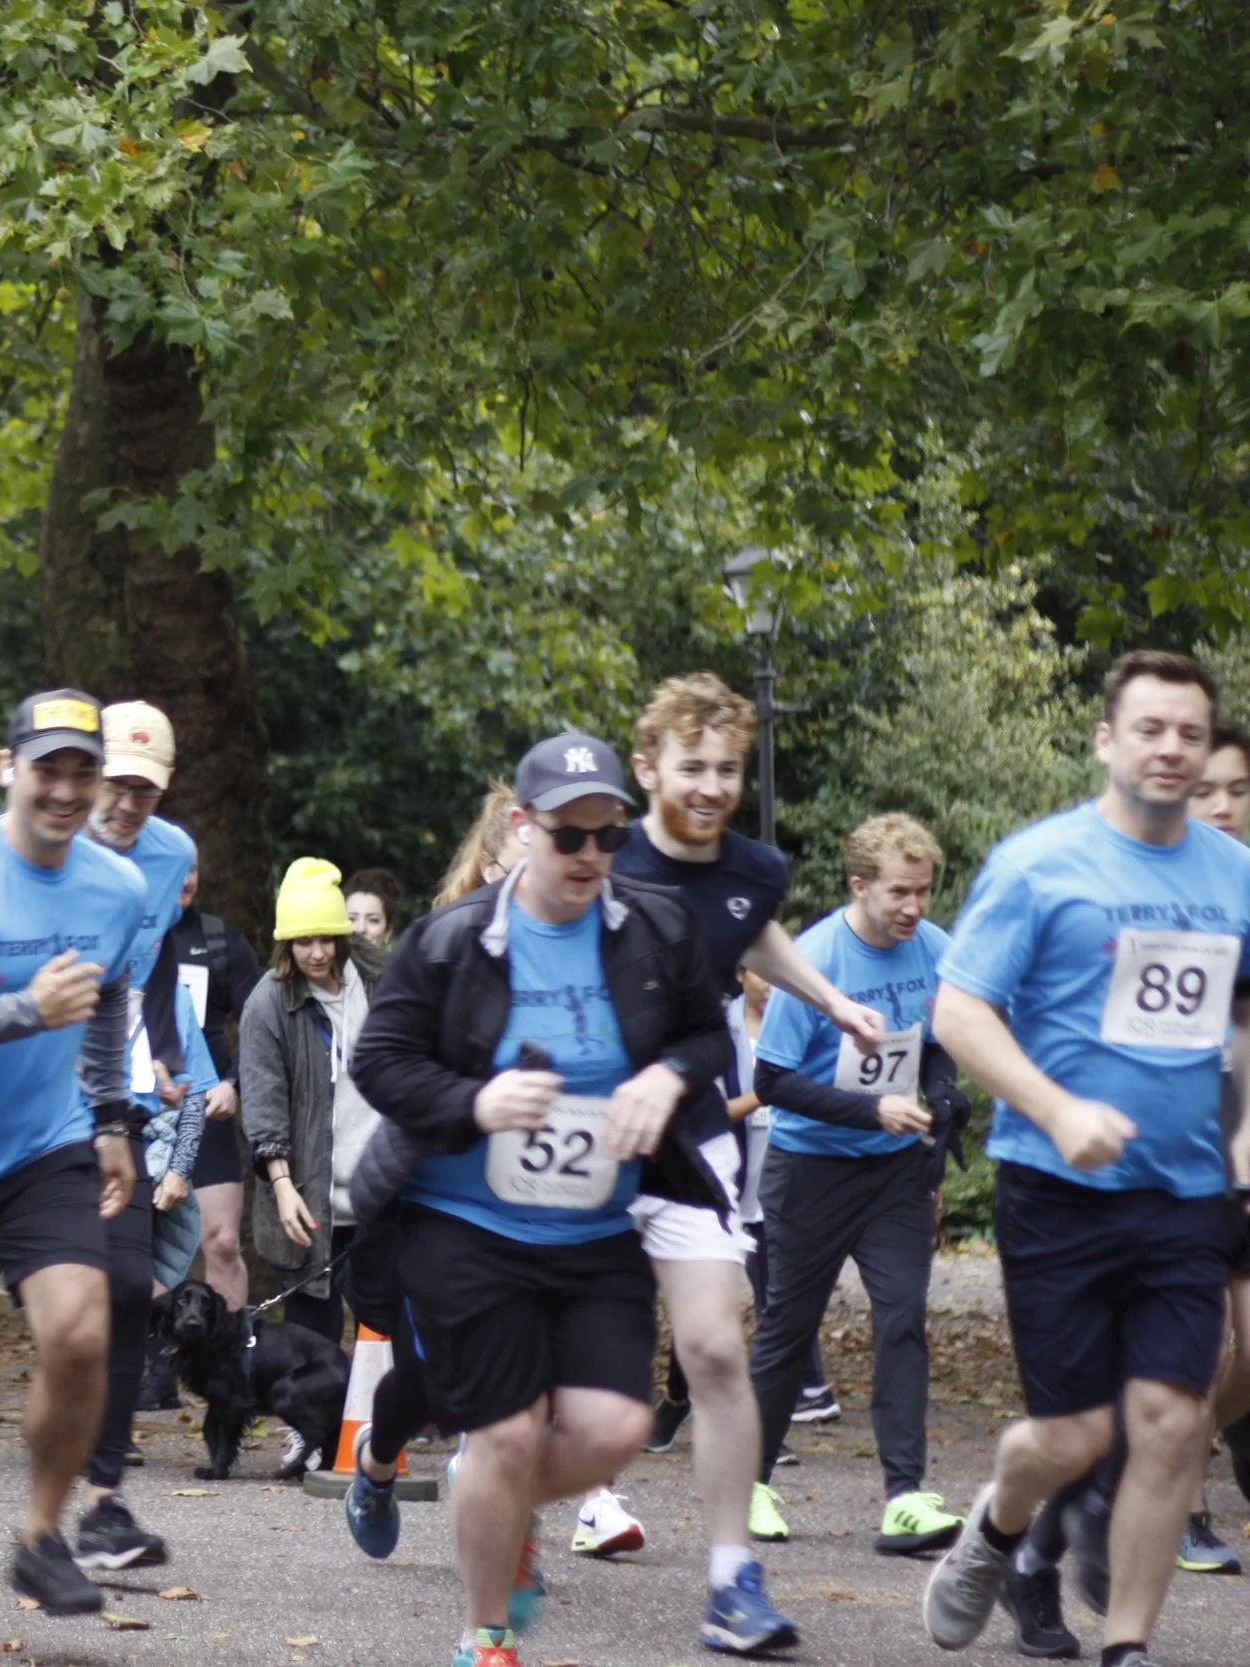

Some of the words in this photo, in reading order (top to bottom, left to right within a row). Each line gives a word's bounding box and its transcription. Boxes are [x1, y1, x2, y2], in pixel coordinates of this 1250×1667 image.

[1103, 904, 1171, 924] TERRY
[1186, 904, 1230, 923] FOX
[896, 977, 926, 995] FOX
[1136, 962, 1207, 1016] 89
[858, 1050, 908, 1086] 97
[519, 1126, 594, 1178] 52
